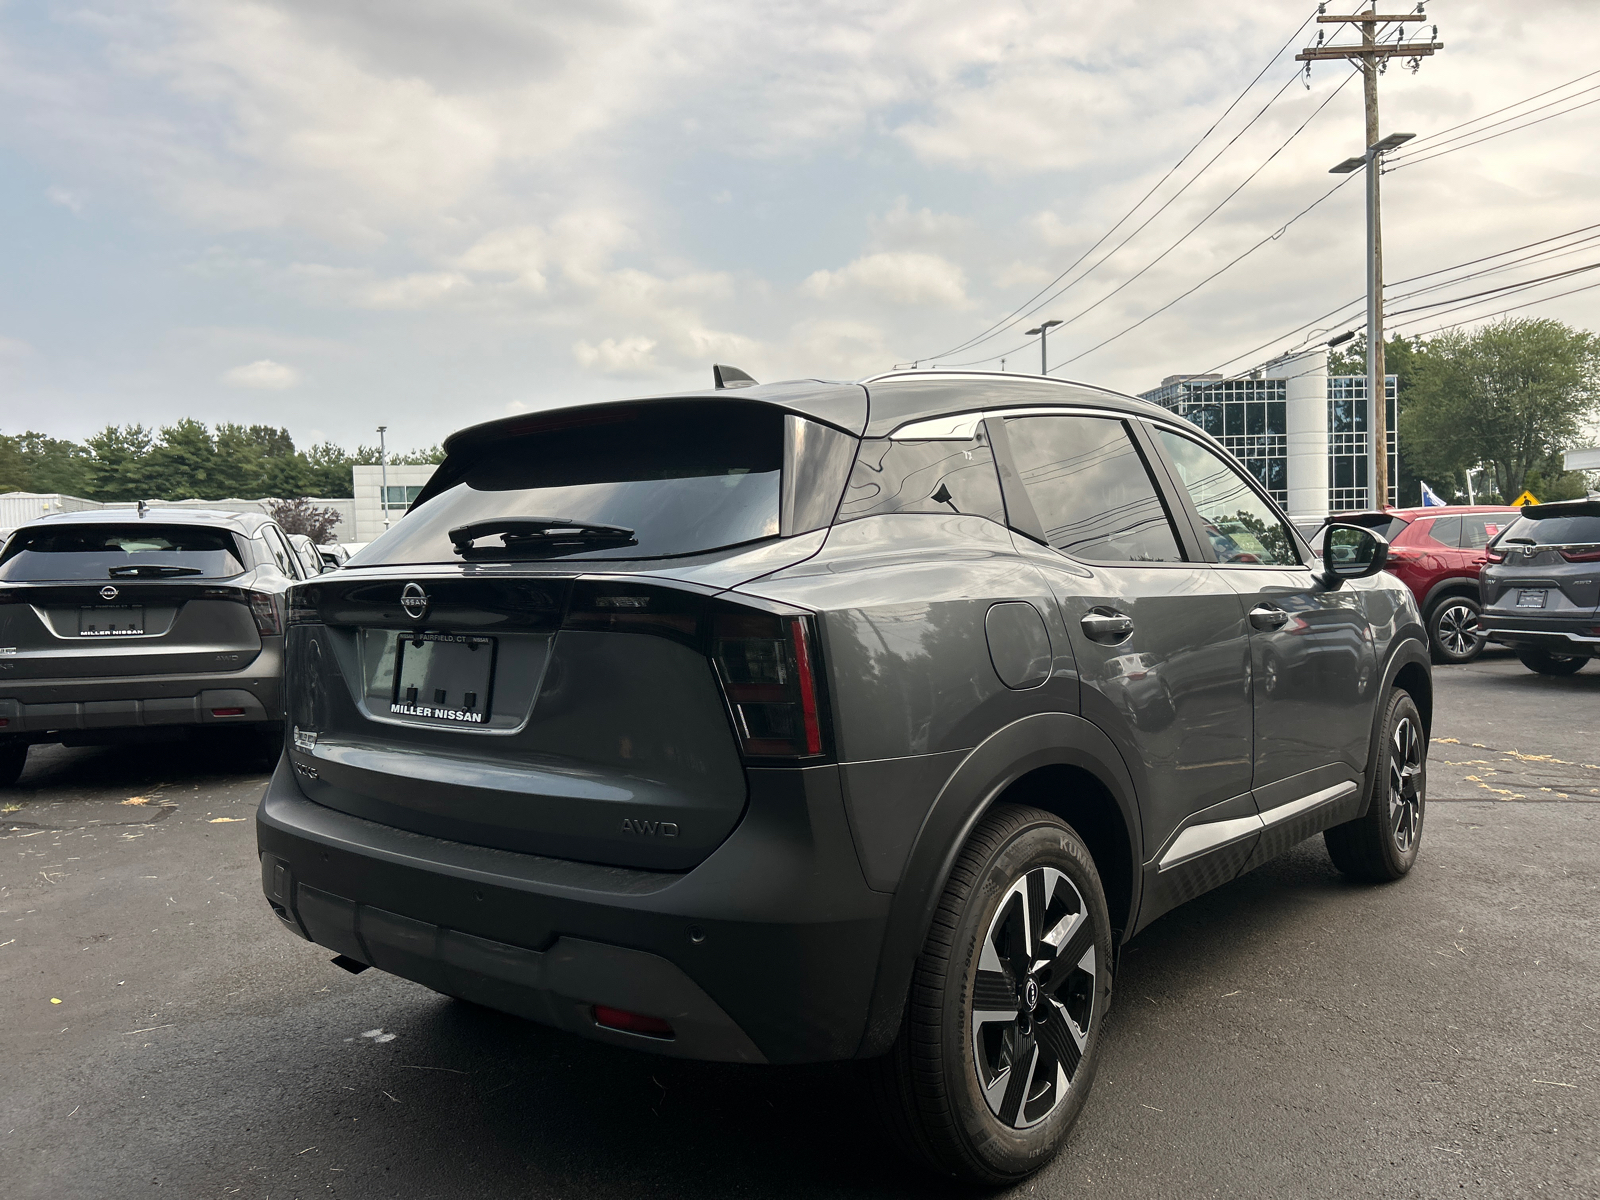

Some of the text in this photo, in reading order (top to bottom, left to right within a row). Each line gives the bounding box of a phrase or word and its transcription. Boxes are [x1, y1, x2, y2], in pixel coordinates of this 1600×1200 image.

[419, 634, 455, 643] FAIRFIELD,
[215, 654, 239, 662] AWD
[390, 703, 482, 723] MILLER NISSAN
[620, 817, 681, 838] AWD
